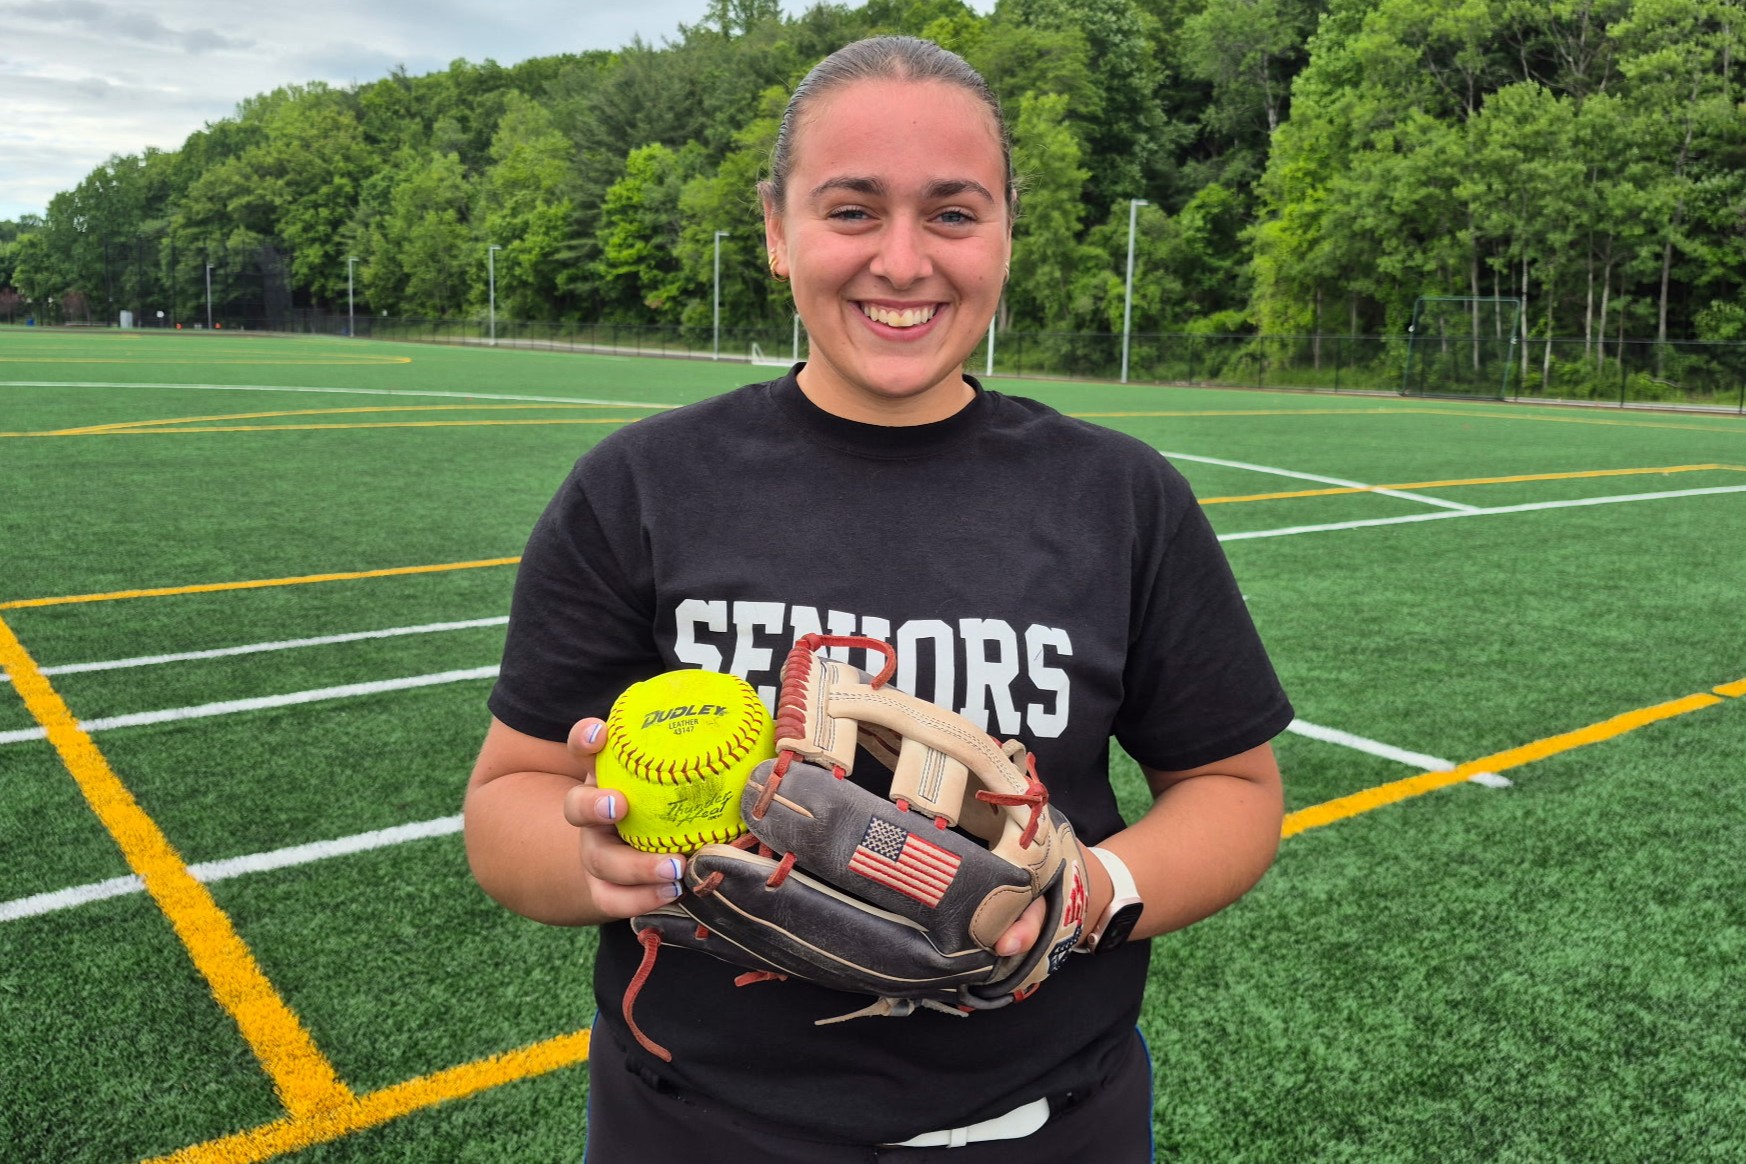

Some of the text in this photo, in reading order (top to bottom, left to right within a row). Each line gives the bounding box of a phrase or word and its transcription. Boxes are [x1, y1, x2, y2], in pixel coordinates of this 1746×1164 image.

[641, 705, 727, 729] DUDLEY
[669, 719, 699, 729] LEATHER
[668, 791, 732, 816] Thunder
[676, 795, 733, 827] Heat
